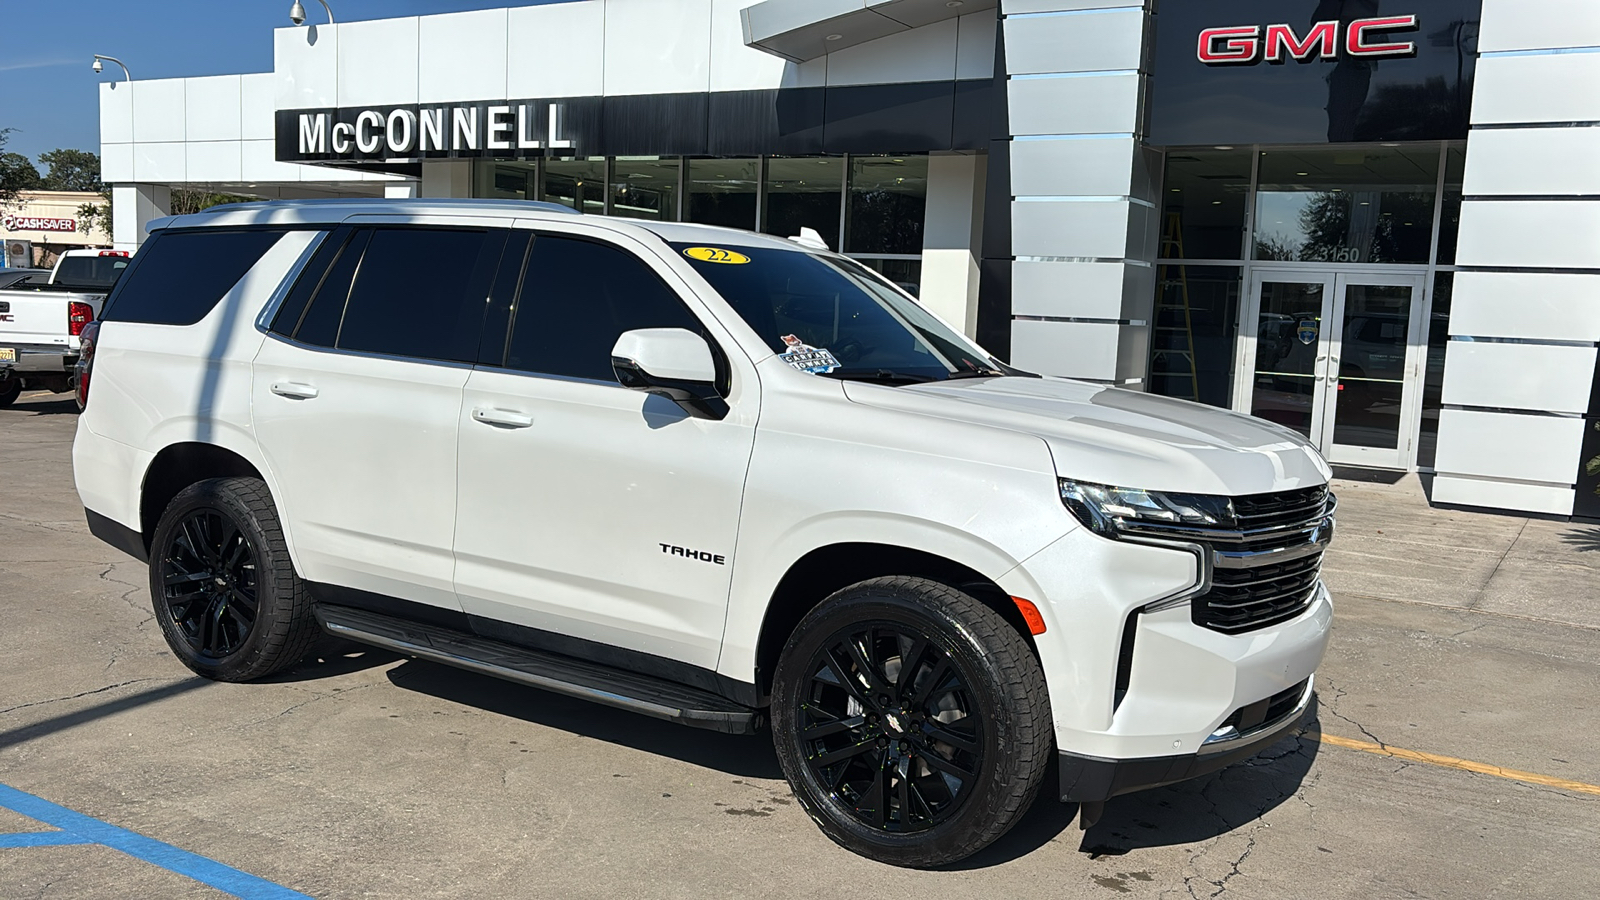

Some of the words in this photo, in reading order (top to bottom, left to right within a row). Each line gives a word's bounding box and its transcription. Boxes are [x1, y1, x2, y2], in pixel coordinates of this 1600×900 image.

[1197, 14, 1417, 63] GMC
[299, 104, 573, 154] McCONNELL
[16, 218, 73, 230] CASHSAVER
[704, 248, 731, 261] 22
[1320, 246, 1360, 262] 3150
[0, 314, 15, 323] MC
[784, 351, 831, 362] CARFAX
[658, 542, 726, 566] TAHOE
